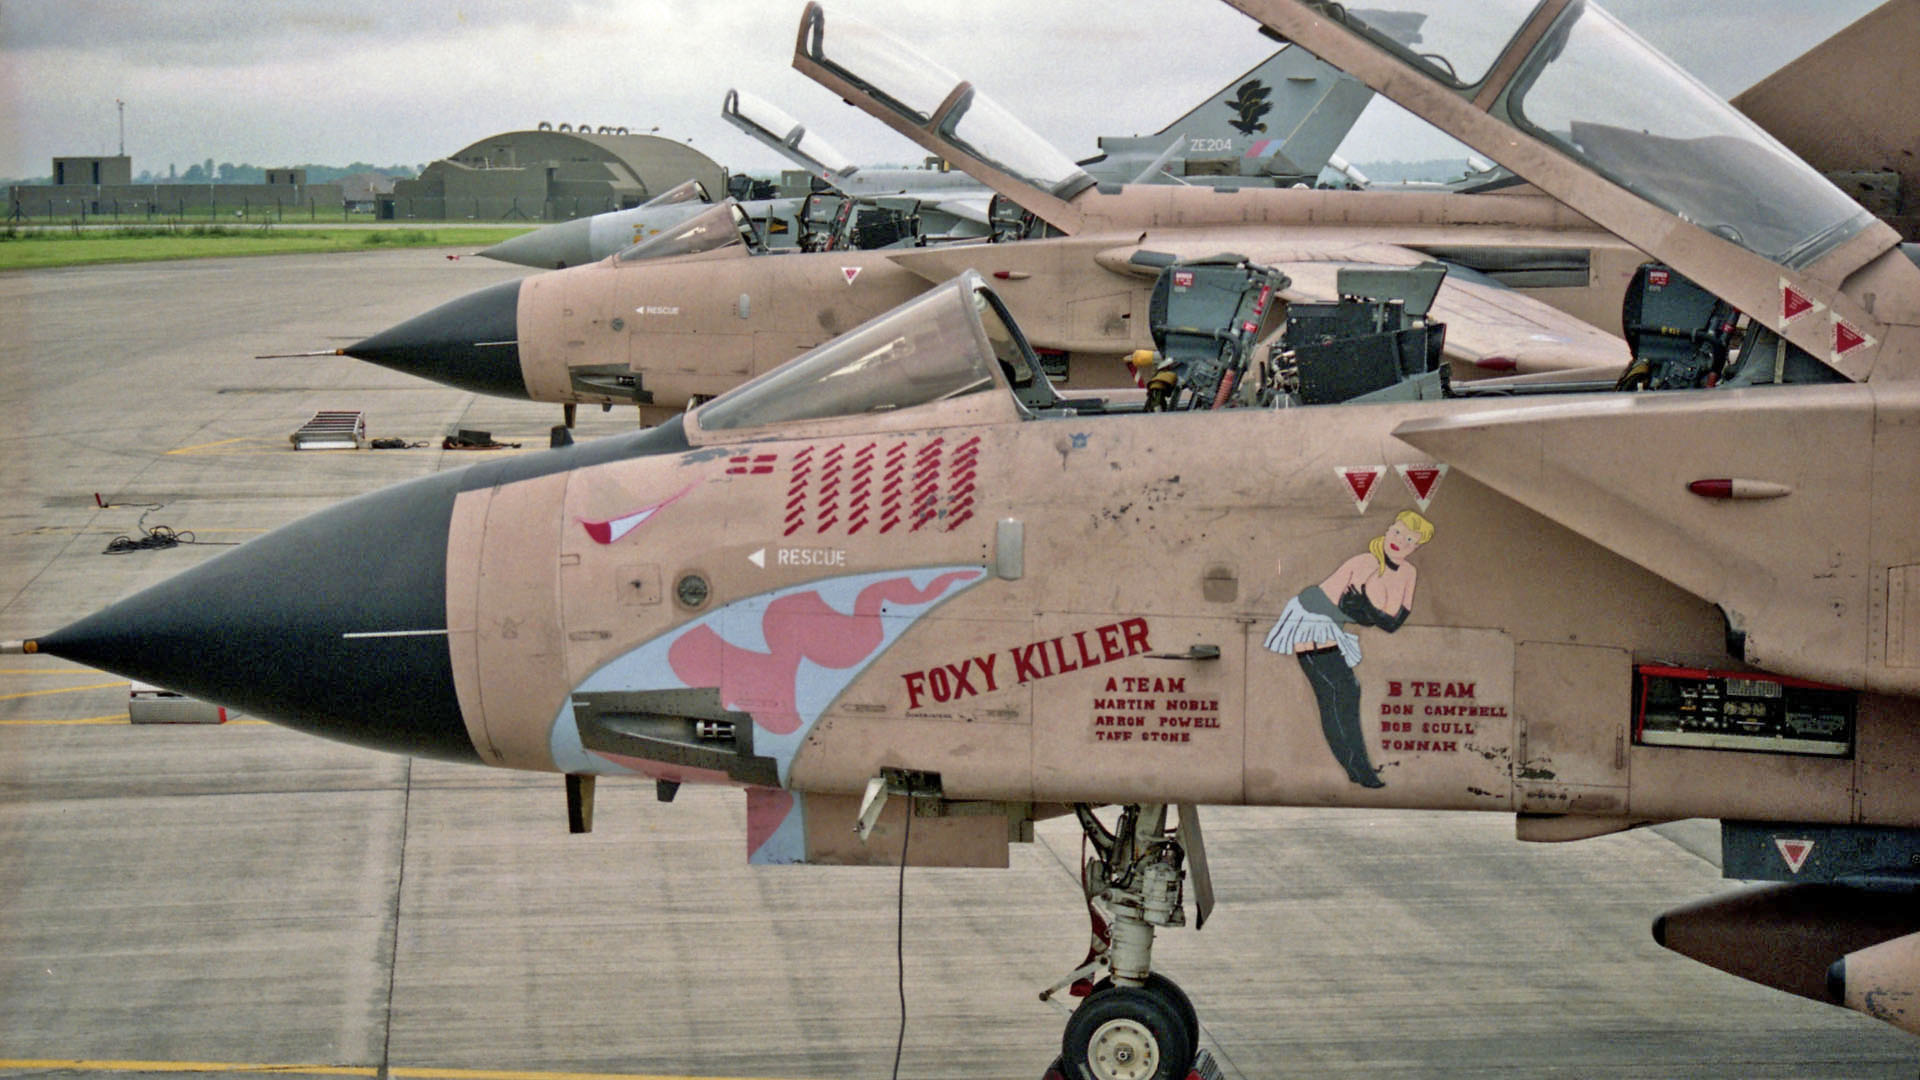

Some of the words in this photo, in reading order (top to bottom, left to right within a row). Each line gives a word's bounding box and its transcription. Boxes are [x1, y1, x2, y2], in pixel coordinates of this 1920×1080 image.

[1190, 138, 1232, 151] ZE204
[777, 548, 846, 566] RESCUE
[901, 653, 997, 710] FOXY
[1009, 617, 1153, 684] KILLER
[1105, 677, 1117, 692] A
[1122, 677, 1185, 693] TEAM
[1387, 681, 1402, 697] B
[1411, 681, 1475, 698] TEAM
[1094, 698, 1155, 710] MARTIN
[1166, 700, 1218, 711] NOBLE
[1381, 704, 1414, 715] DON
[1424, 705, 1507, 717] CAMPBELL
[1095, 716, 1145, 726] ARRON
[1159, 717, 1220, 728] POWELL
[1381, 721, 1412, 732] BOB
[1422, 723, 1474, 734] SCULL
[1095, 731, 1132, 741] TAFF
[1141, 732, 1190, 742] STONE
[1382, 740, 1457, 751] JONNAH
